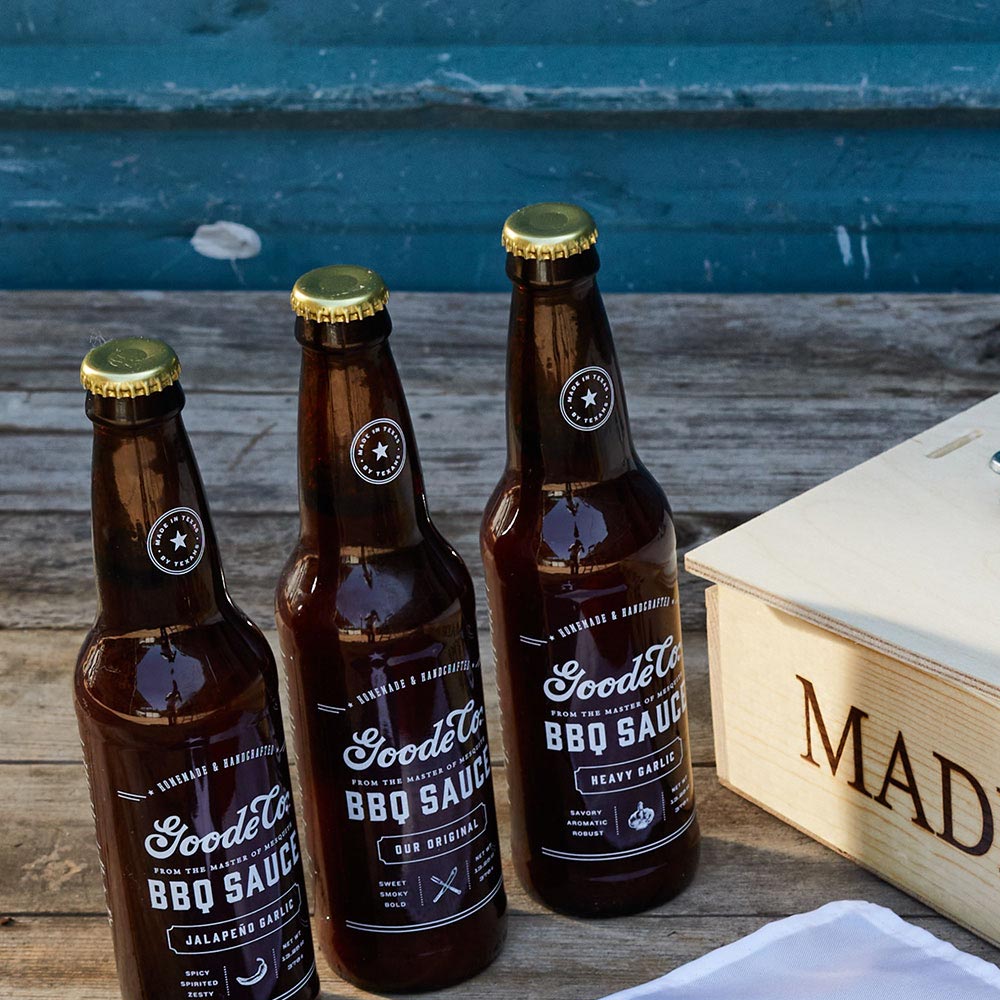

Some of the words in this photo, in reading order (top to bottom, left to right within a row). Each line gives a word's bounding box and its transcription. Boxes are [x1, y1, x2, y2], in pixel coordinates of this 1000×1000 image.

[568, 381, 580, 402] MADE
[593, 375, 608, 391] TEXAS
[572, 412, 581, 420] BY
[584, 402, 608, 423] TEXANS
[358, 434, 370, 455] MADE
[384, 427, 400, 443] TEXAS
[363, 465, 373, 474] BY
[376, 455, 400, 476] TEXANS
[155, 523, 168, 546] MADE
[182, 516, 199, 533] TEXAS
[160, 556, 170, 564] BY
[174, 544, 199, 566] TEXANS
[558, 614, 606, 637] HOMEMADE
[611, 611, 617, 620] &
[357, 679, 405, 704] HOMEMADE
[410, 676, 417, 684] &
[543, 653, 654, 702] Goode
[544, 721, 607, 755] BBQ
[617, 680, 686, 747] SAUCE
[551, 710, 577, 718] FROM
[605, 702, 641, 715] MASTER
[644, 695, 654, 704] OF
[343, 719, 455, 770] Goode
[157, 765, 208, 792] HOMEMADE
[212, 762, 219, 772] &
[407, 767, 444, 783] MASTER
[447, 761, 457, 770] OF
[592, 770, 632, 786] HEAVY
[638, 751, 675, 777] GARLIC
[345, 790, 410, 825] BBQ
[420, 744, 490, 815] SAUCE
[145, 805, 260, 859] Goode
[395, 842, 420, 854] OUR
[427, 819, 478, 849] ORIGINAL
[148, 879, 214, 914] BBQ
[224, 829, 299, 903] SAUCE
[185, 866, 206, 874] THE
[210, 855, 248, 871] MASTER
[251, 848, 261, 858] OF
[186, 922, 255, 945] JALAPEÑO
[260, 898, 294, 928] GARLIC
